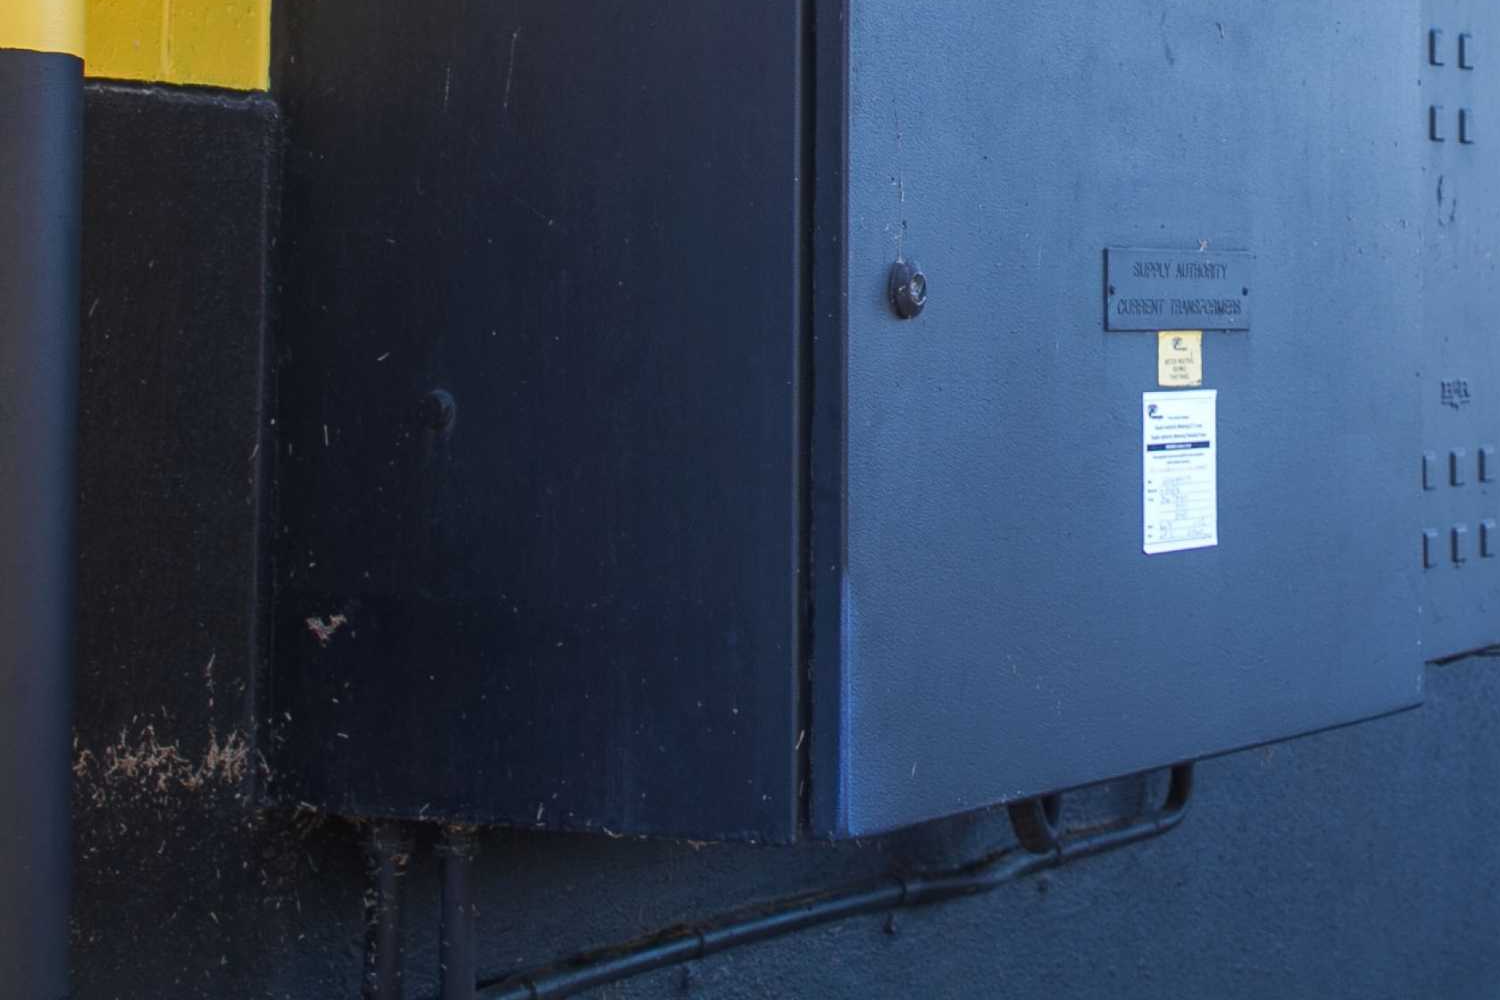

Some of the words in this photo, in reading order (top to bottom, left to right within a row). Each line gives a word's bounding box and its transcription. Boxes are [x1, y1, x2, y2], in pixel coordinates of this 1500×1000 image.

[1132, 261, 1171, 278] SUPPLY
[1175, 263, 1228, 280] AUTHORITY
[1117, 298, 1164, 315] CURRENT
[1169, 299, 1242, 316] TRANSFORMERS
